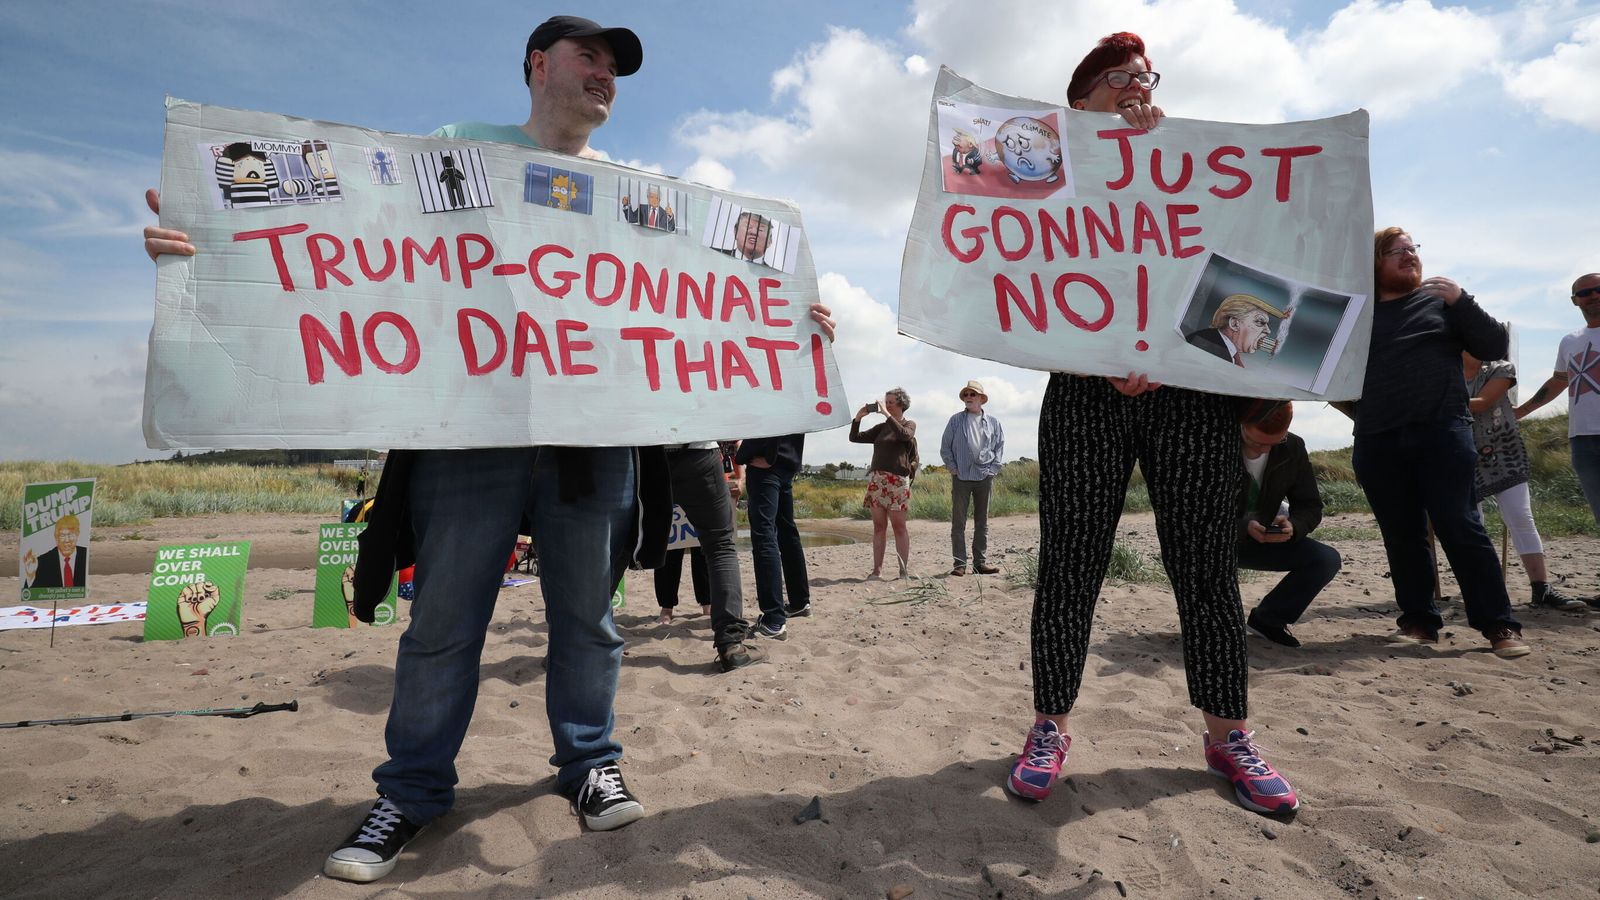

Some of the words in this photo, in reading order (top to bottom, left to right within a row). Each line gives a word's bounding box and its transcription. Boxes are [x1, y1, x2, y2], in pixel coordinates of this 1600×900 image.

[253, 142, 301, 153] MOMMY!
[1097, 127, 1323, 202] JUST
[942, 202, 1205, 264] GONNAE
[233, 223, 793, 327] TRUMP-GONNAE
[994, 265, 1152, 352] NO!
[299, 311, 421, 385] NO
[456, 307, 598, 377] DAE
[619, 326, 833, 416] THAT!
[25, 485, 78, 522] DUMP
[27, 496, 91, 532] TRUMP
[320, 540, 359, 552] OVER
[322, 527, 344, 538] WE
[155, 560, 202, 573] OVER
[160, 548, 186, 560] WE
[189, 546, 240, 559] SHALL
[153, 573, 206, 587] COMB
